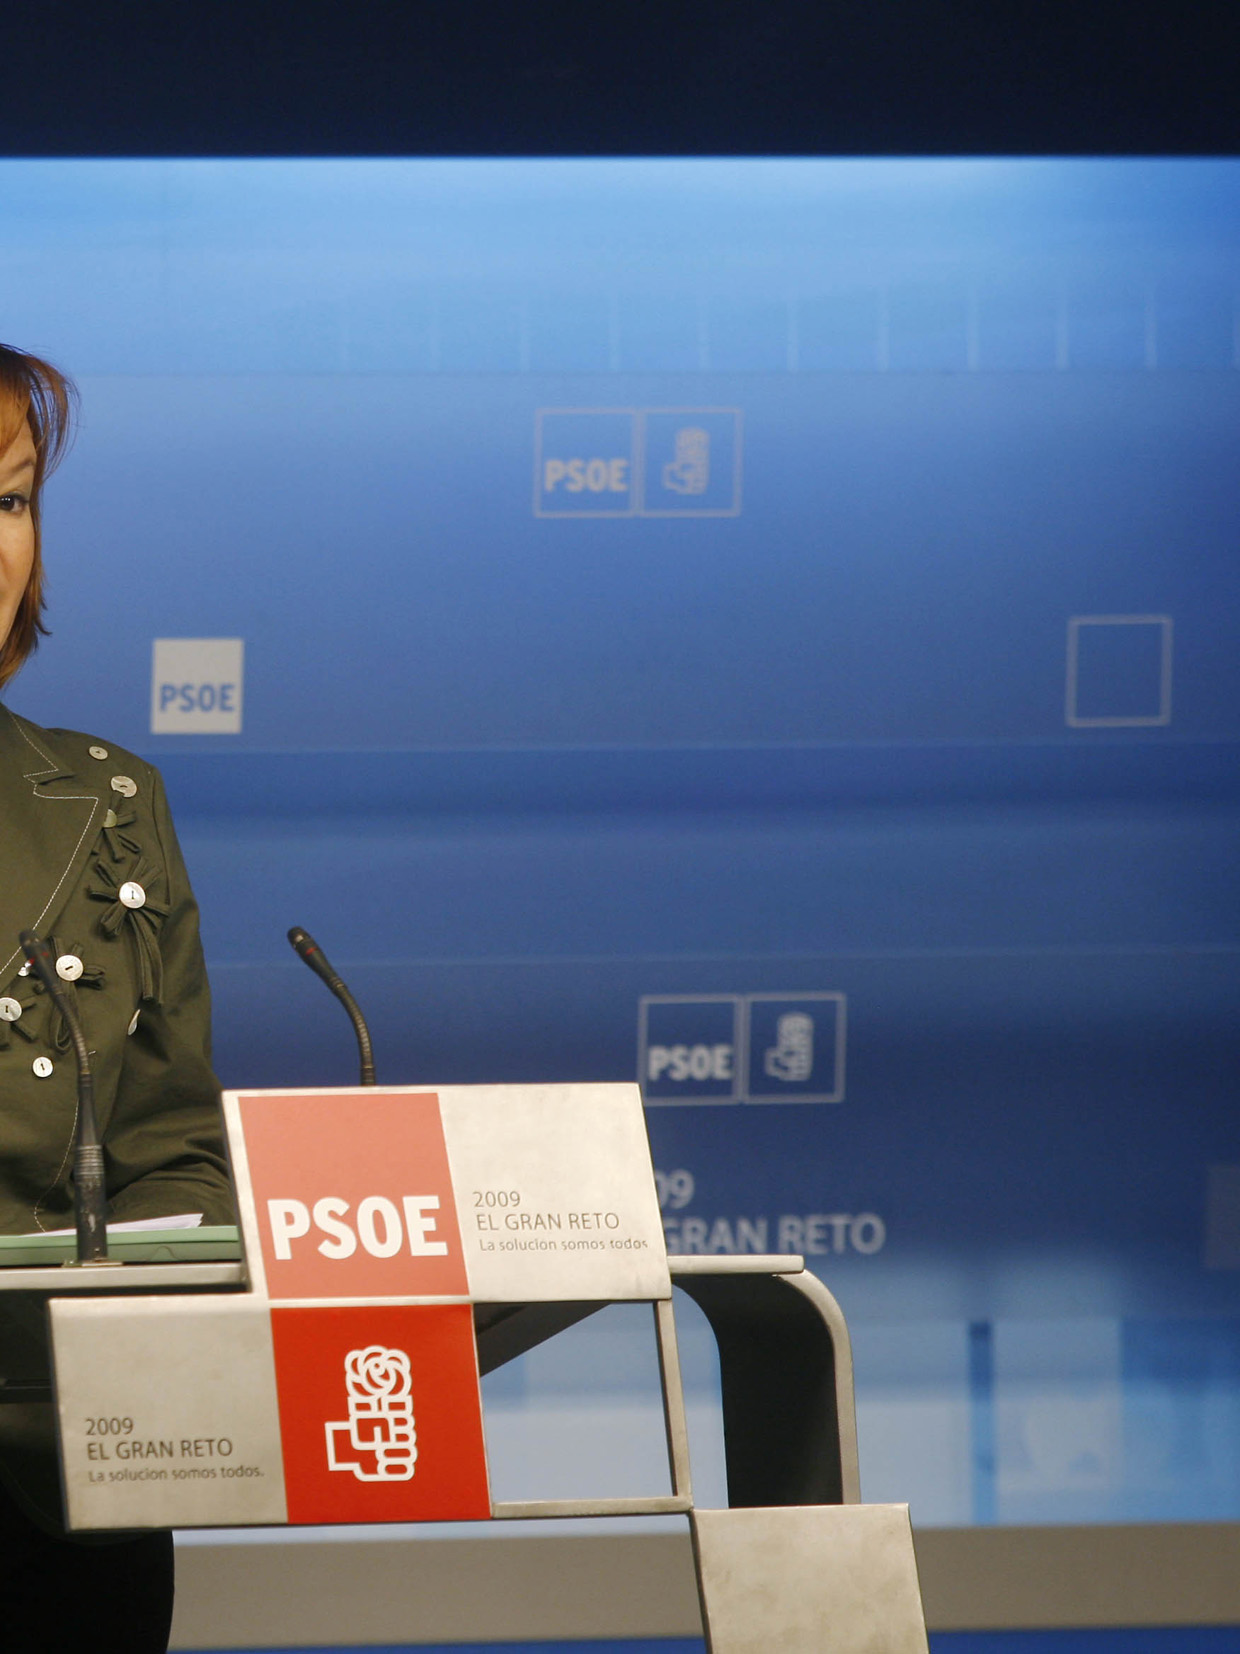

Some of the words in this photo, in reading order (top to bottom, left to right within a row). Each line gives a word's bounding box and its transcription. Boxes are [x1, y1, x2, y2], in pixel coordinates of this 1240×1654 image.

[545, 459, 628, 492] PSOE
[160, 683, 235, 713] PSOE
[649, 1045, 733, 1081] PSOE
[473, 1191, 521, 1208] 2009
[267, 1195, 449, 1261] PSOE
[476, 1214, 499, 1231] EL
[504, 1214, 561, 1231] GRAN
[568, 1212, 620, 1230] RETO
[479, 1239, 495, 1252] La
[499, 1237, 558, 1252] solucion
[561, 1239, 605, 1251] somos
[609, 1237, 649, 1250] todos
[778, 1213, 886, 1255] RETO
[85, 1417, 134, 1436] 2009
[87, 1442, 112, 1461] EL
[115, 1440, 174, 1460] GRAN
[181, 1438, 233, 1457] RETO
[89, 1470, 105, 1482] La
[108, 1465, 168, 1481] solucion
[173, 1466, 217, 1480] somos
[221, 1463, 264, 1479] todos.
